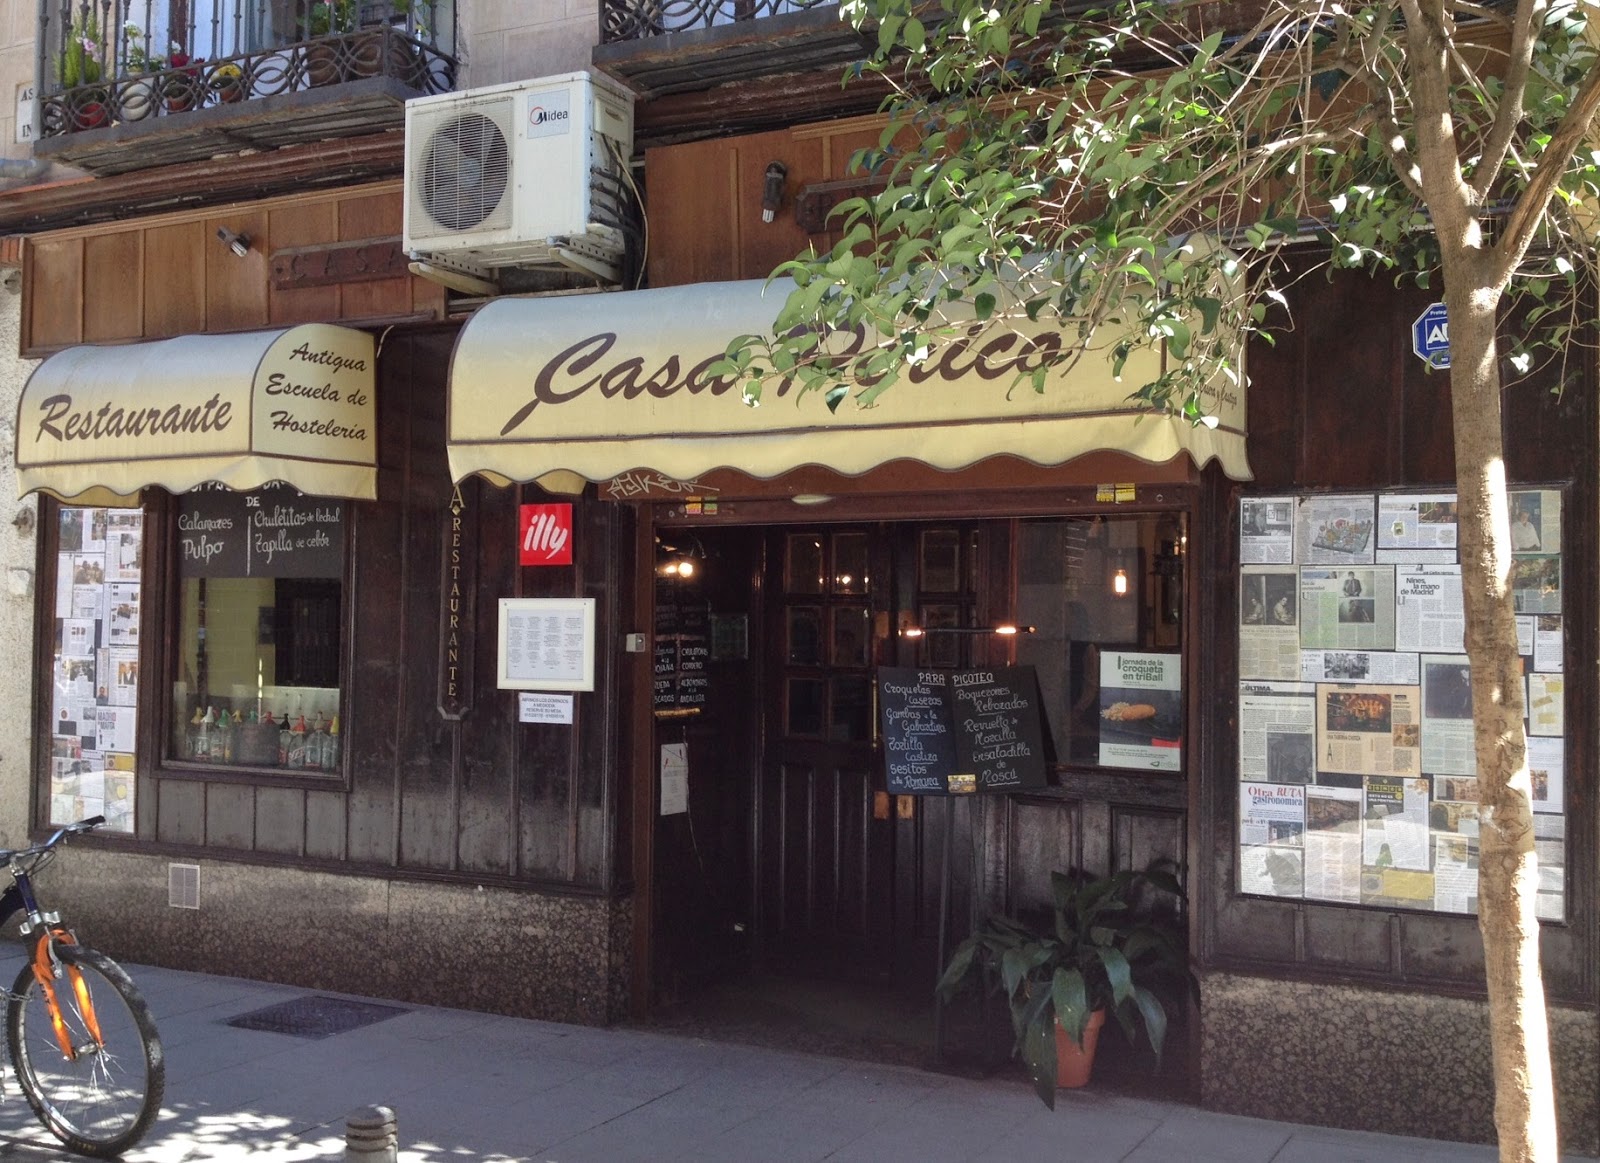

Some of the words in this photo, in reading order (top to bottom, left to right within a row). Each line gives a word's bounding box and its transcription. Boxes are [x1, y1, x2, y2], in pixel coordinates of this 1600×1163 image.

[532, 109, 568, 123] Midea
[289, 342, 367, 374] Antigua
[265, 373, 341, 402] Escuela
[347, 389, 367, 406] de
[500, 331, 746, 436] Casa
[35, 392, 233, 444] Restaurante
[270, 410, 367, 441] Hostelería
[245, 496, 260, 507] DE
[178, 511, 233, 531] Calamares
[524, 513, 568, 560] illy
[182, 535, 225, 566] Pulpo
[448, 517, 462, 697] RESTAURANTE
[918, 672, 945, 684] PARA
[952, 672, 994, 685] PICOTEO
[1122, 666, 1164, 674] croqueta
[884, 682, 931, 700] Croquetas
[956, 686, 1010, 704] Boquerones
[908, 696, 942, 706] Caseras
[975, 694, 1029, 713] Rebozados
[886, 708, 921, 725] Gambas
[964, 716, 1009, 732] Revuelto
[972, 742, 1031, 762] Ensaladilla
[890, 764, 927, 775] Sesitos
[996, 760, 1006, 769] de
[1248, 786, 1273, 797] Otra
[1276, 787, 1302, 798] RUTA
